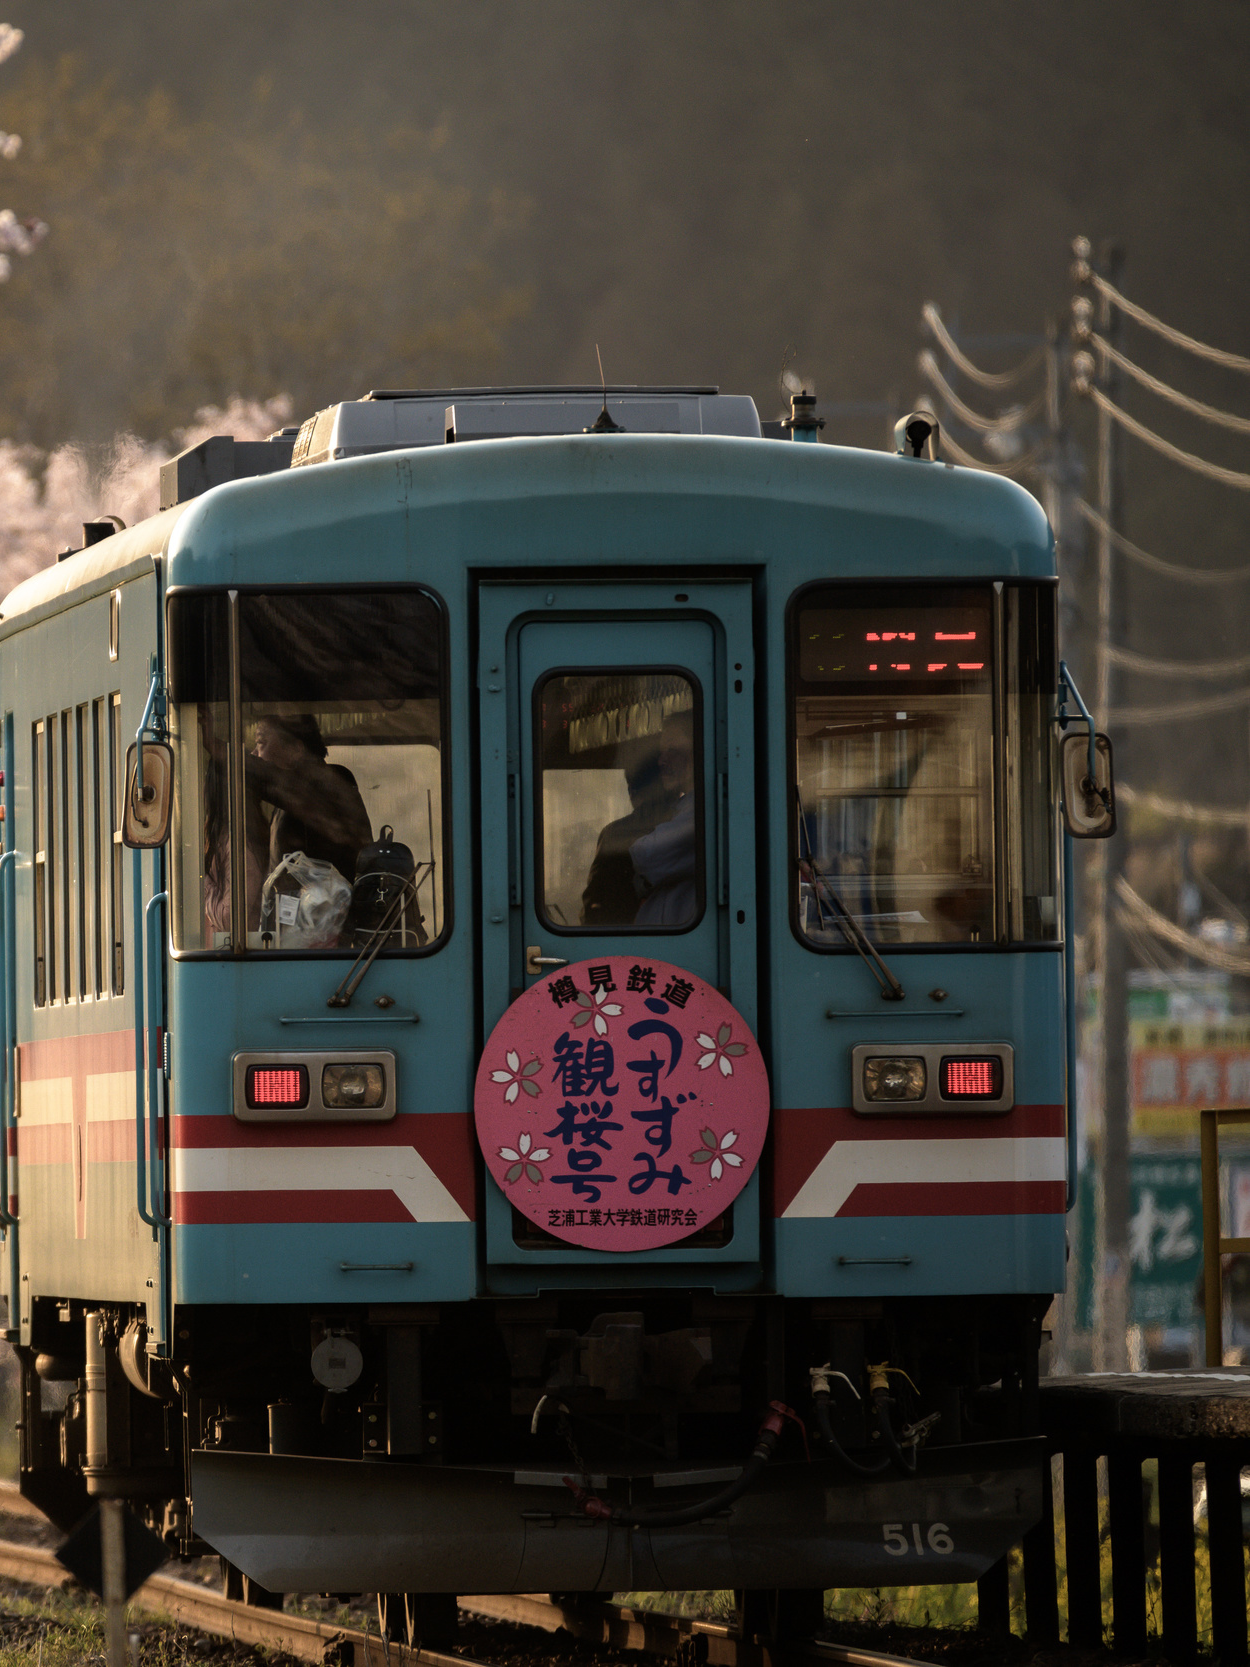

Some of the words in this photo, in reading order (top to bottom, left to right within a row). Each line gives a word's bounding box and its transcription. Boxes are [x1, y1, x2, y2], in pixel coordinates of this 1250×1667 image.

[548, 964, 696, 1010] 樽見鉄道
[543, 1031, 624, 1204] 観桜号
[626, 997, 698, 1196] うすずみ
[547, 1208, 698, 1227] 芝浦工業大学鉄道研究会
[882, 1522, 955, 1556] 516
